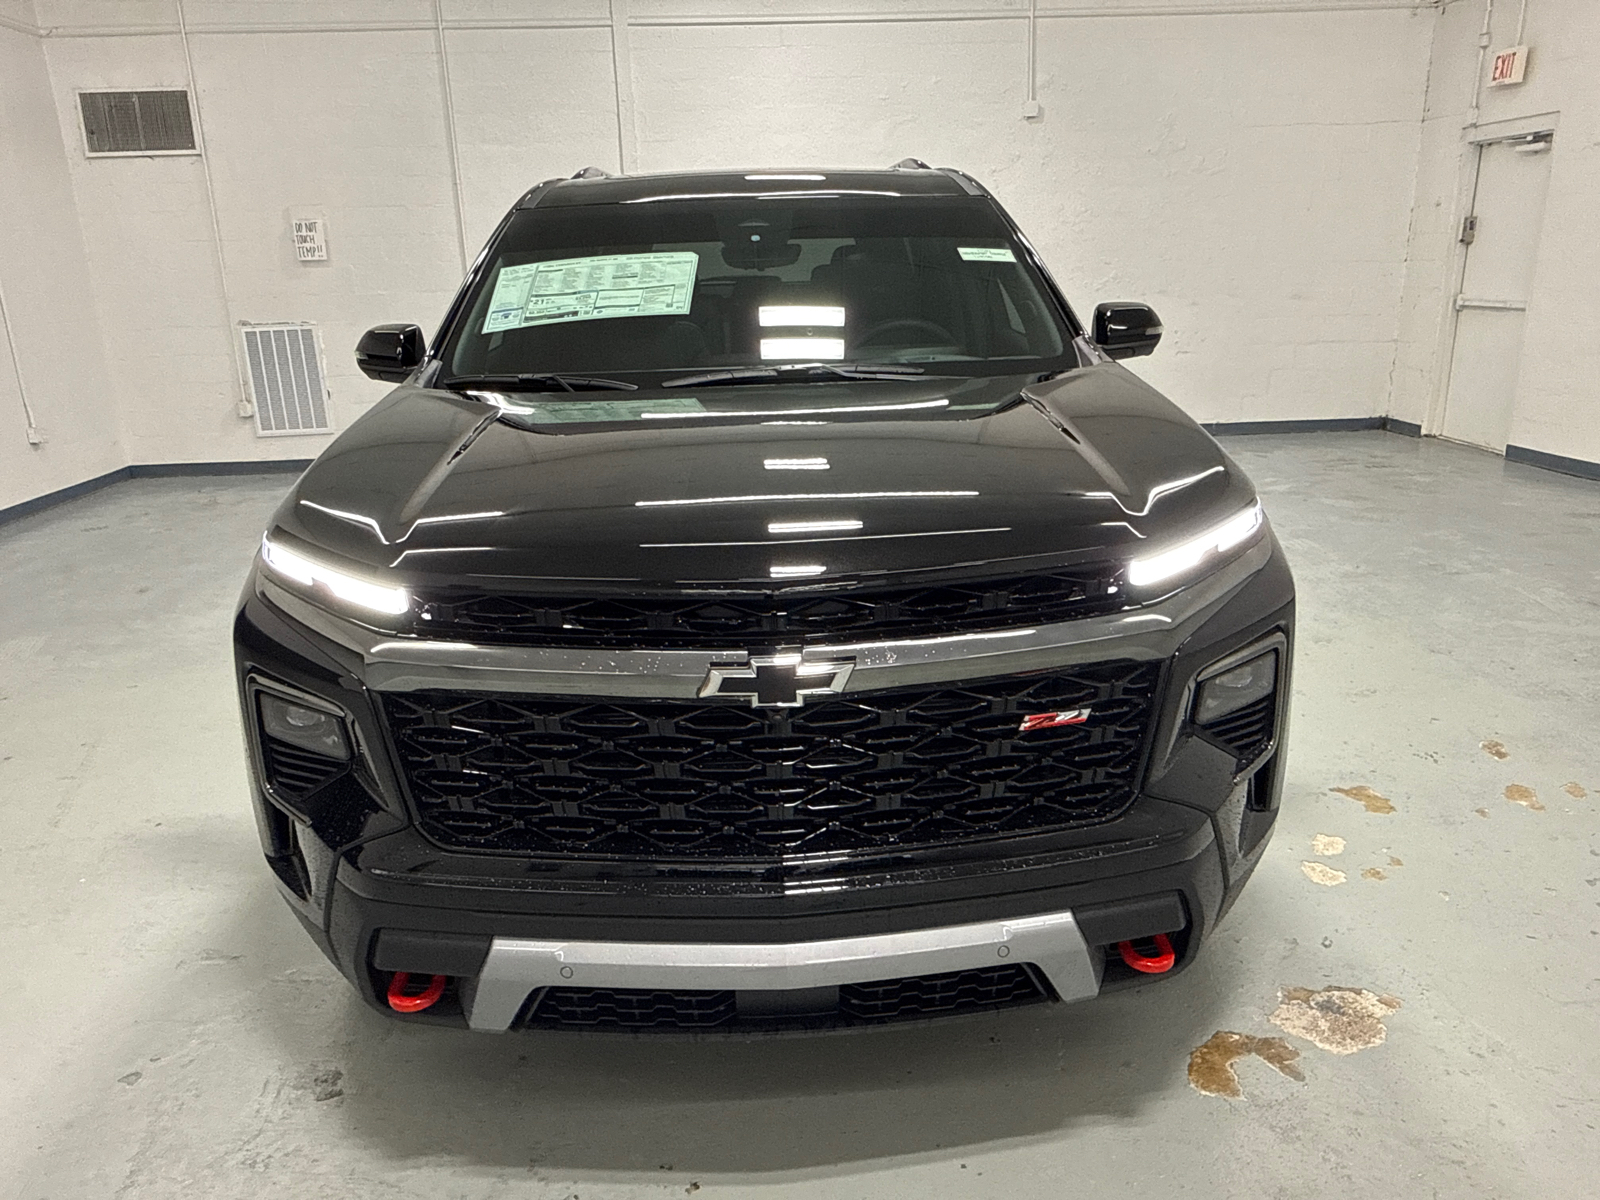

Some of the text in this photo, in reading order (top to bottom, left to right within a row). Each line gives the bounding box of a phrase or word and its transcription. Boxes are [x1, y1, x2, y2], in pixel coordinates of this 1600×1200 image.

[1492, 52, 1517, 81] EXIT
[294, 221, 318, 234] DO NOT
[295, 234, 316, 245] TOUCH
[297, 245, 324, 258] TEMP!!
